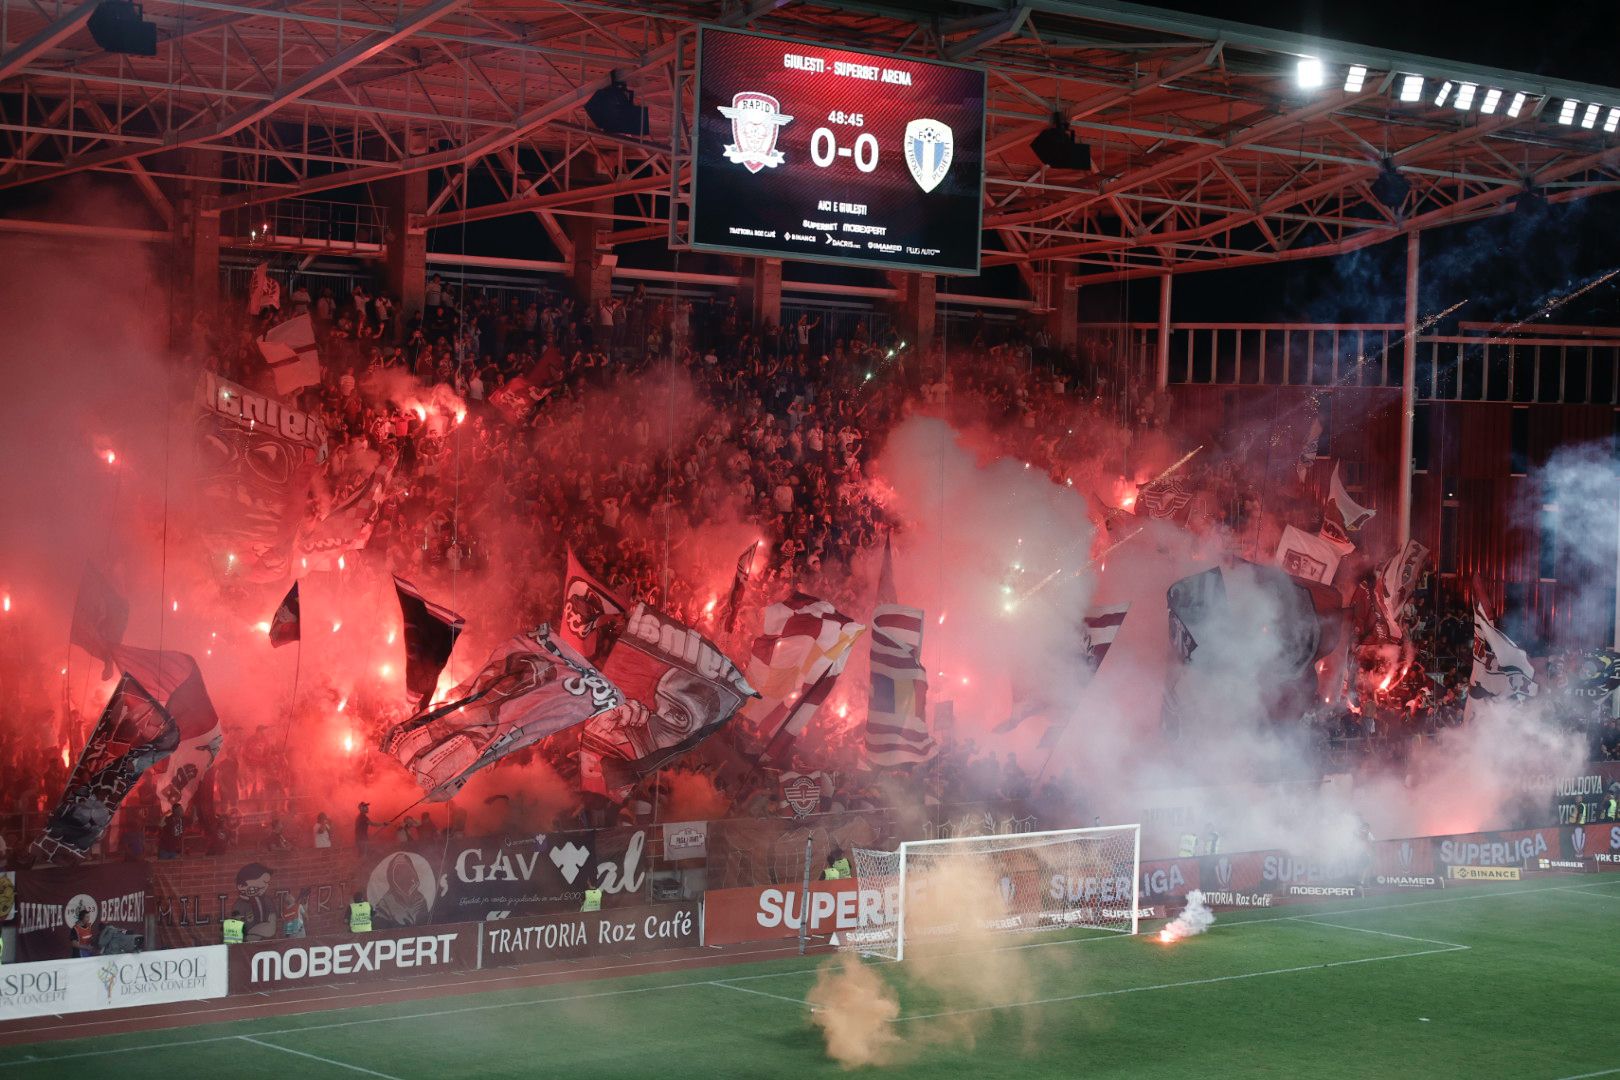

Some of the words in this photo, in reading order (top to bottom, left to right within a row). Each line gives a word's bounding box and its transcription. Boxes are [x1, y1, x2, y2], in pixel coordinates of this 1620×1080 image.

[834, 61, 879, 81] SUPERBET
[881, 68, 912, 86] ARENA
[742, 100, 770, 113] RAPID
[828, 110, 864, 127] 48:45
[802, 219, 838, 231] SUPERBET
[842, 223, 887, 236] MOBEXPERT
[791, 234, 816, 242] BINANCE
[1556, 775, 1603, 797] MOLDOVA
[1439, 832, 1548, 865] SUPERLIGA
[1551, 860, 1585, 868] BARRIER
[1594, 853, 1611, 862] VRK
[1387, 876, 1435, 885] IMAMED
[1470, 869, 1516, 878] BINANCE
[1290, 886, 1355, 896] MOBEXPERT
[100, 891, 145, 922] BERCENI
[1235, 893, 1249, 906] Roz
[489, 921, 588, 954] TRATTORIA
[598, 920, 636, 944] Roz
[644, 910, 692, 939] Café
[251, 933, 459, 983] MOBEXPERT
[119, 957, 207, 985] CASPOL
[0, 970, 67, 997] SPOL
[121, 982, 159, 996] DESIGN
[161, 976, 207, 992] CONCEPT
[17, 991, 65, 1005] CONCEPT
